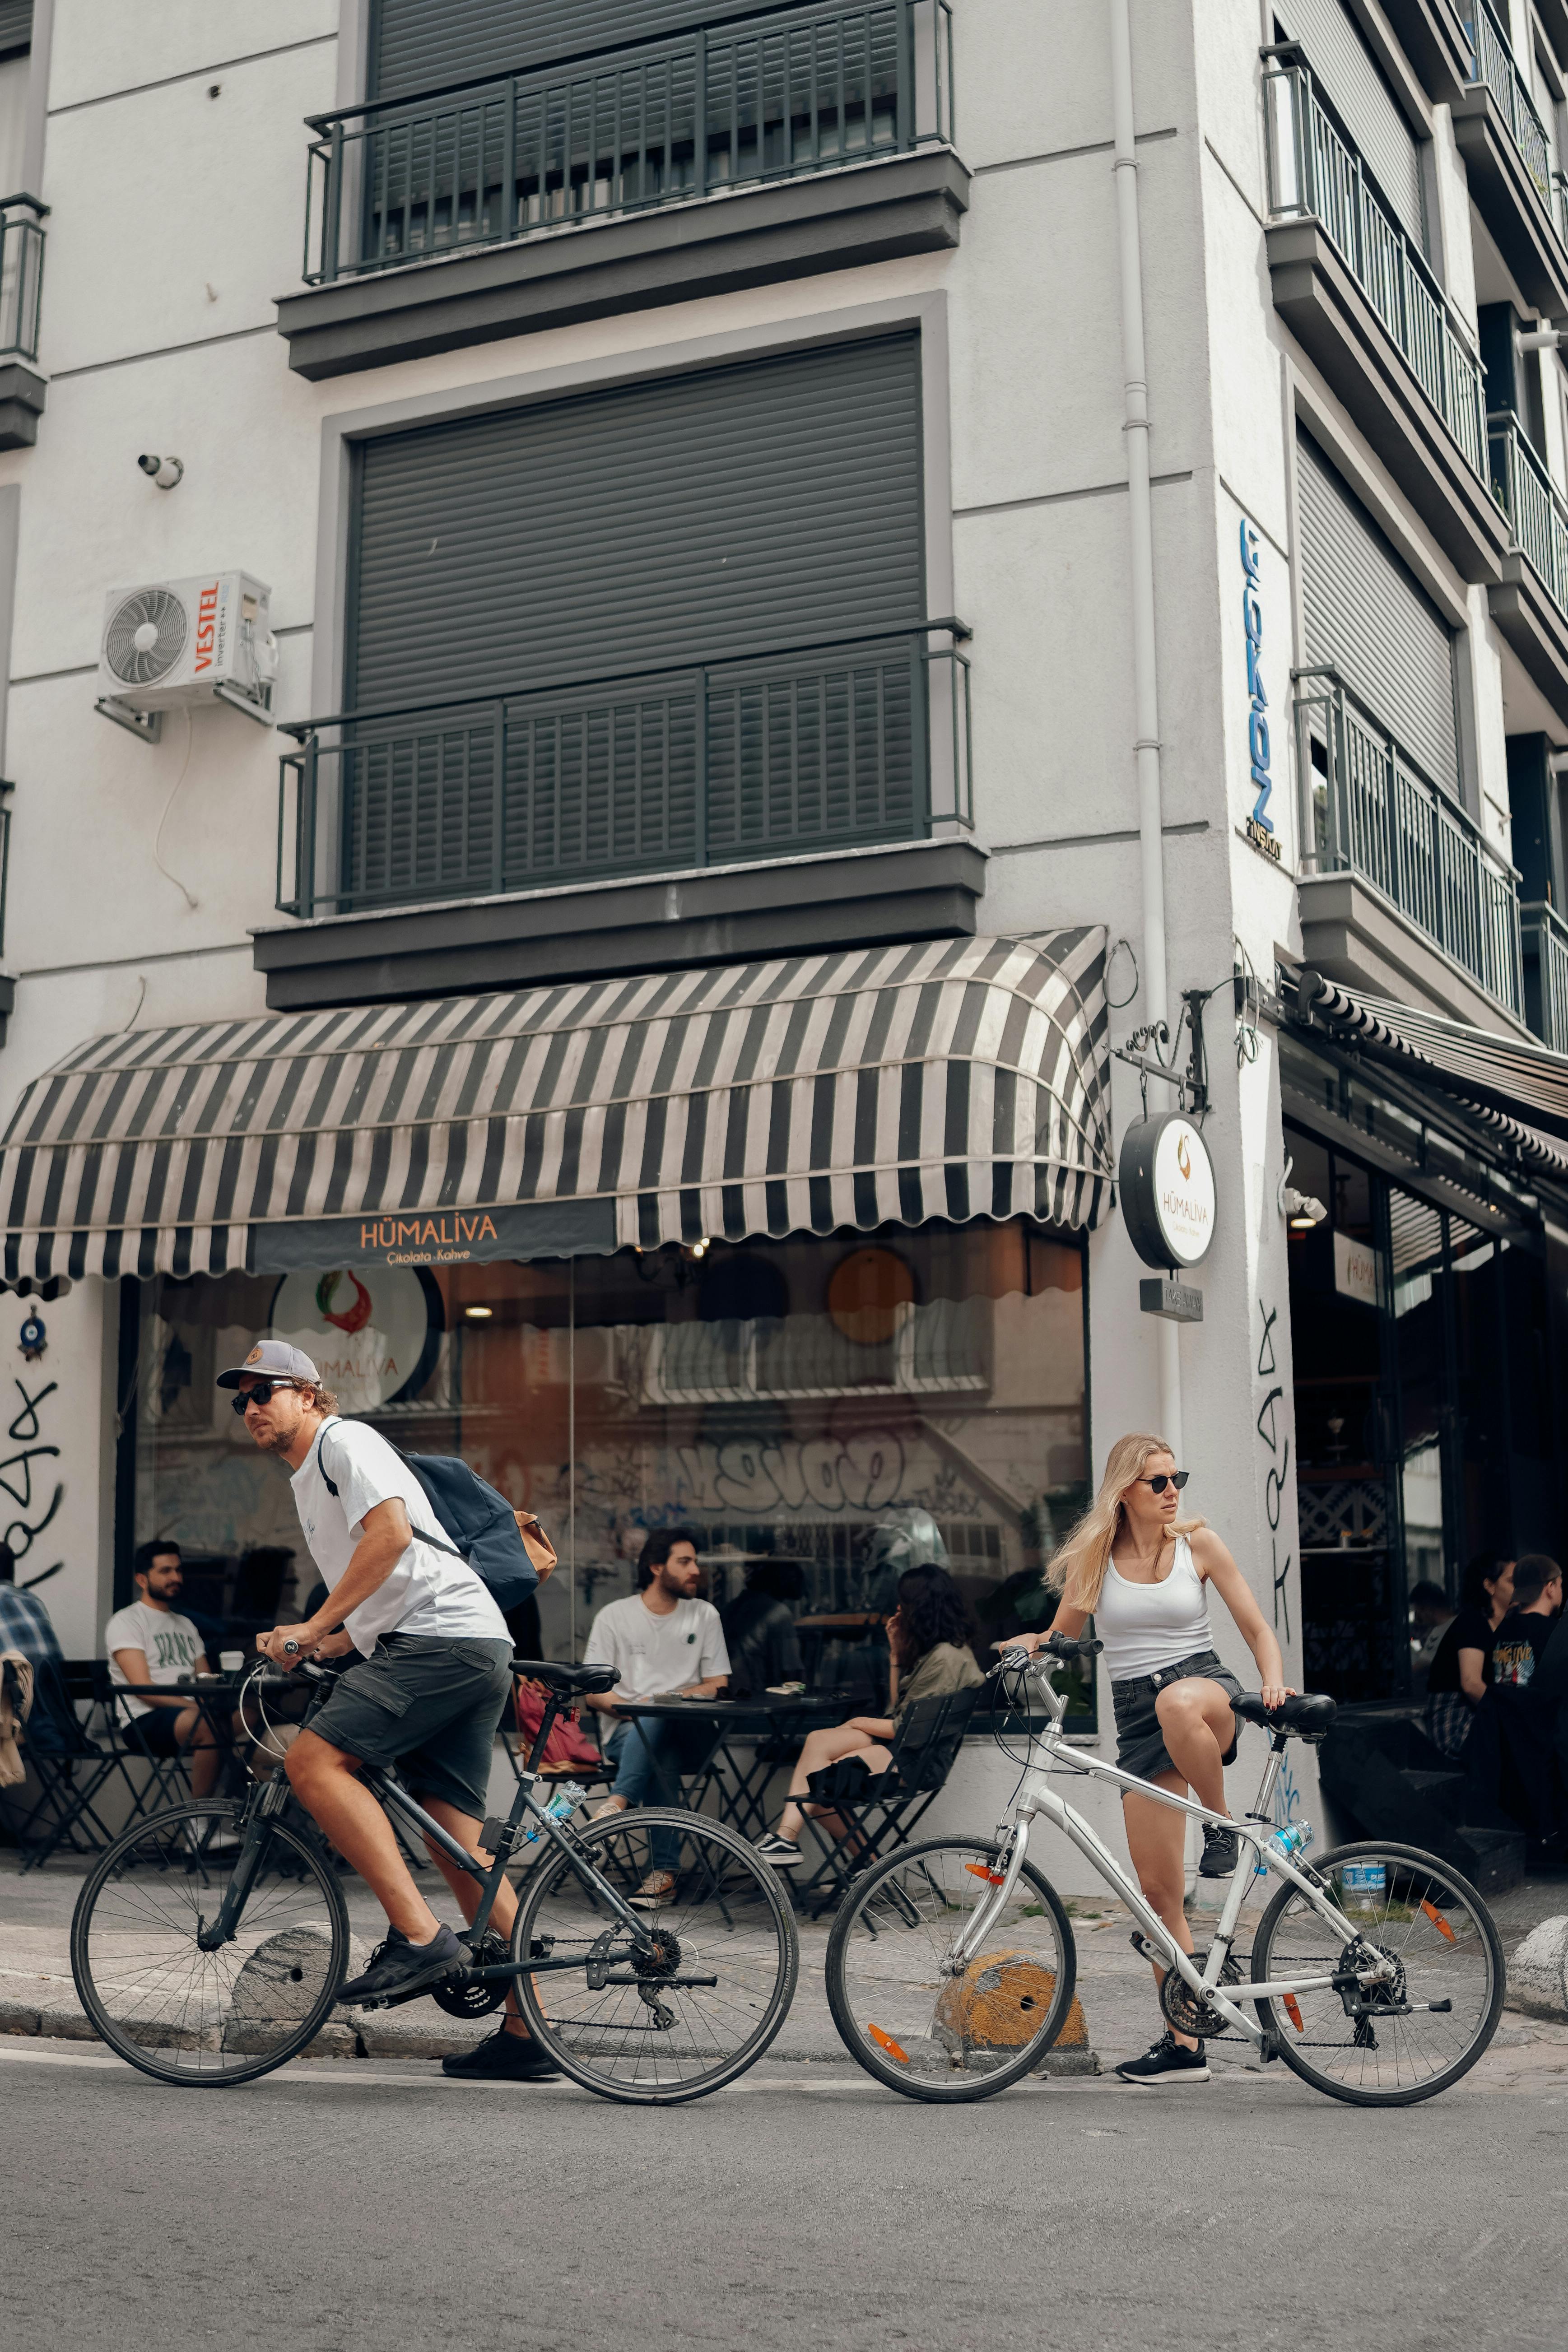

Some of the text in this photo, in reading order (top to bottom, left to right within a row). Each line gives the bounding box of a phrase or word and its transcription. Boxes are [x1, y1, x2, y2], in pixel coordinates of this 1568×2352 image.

[195, 581, 219, 674] VESTEL
[1163, 1191, 1208, 1226] HÜMALİVA
[361, 1212, 498, 1249] HÜMALİVA
[386, 1249, 470, 1266] Çikolata Kahve
[1164, 1287, 1182, 1306] TAKE
